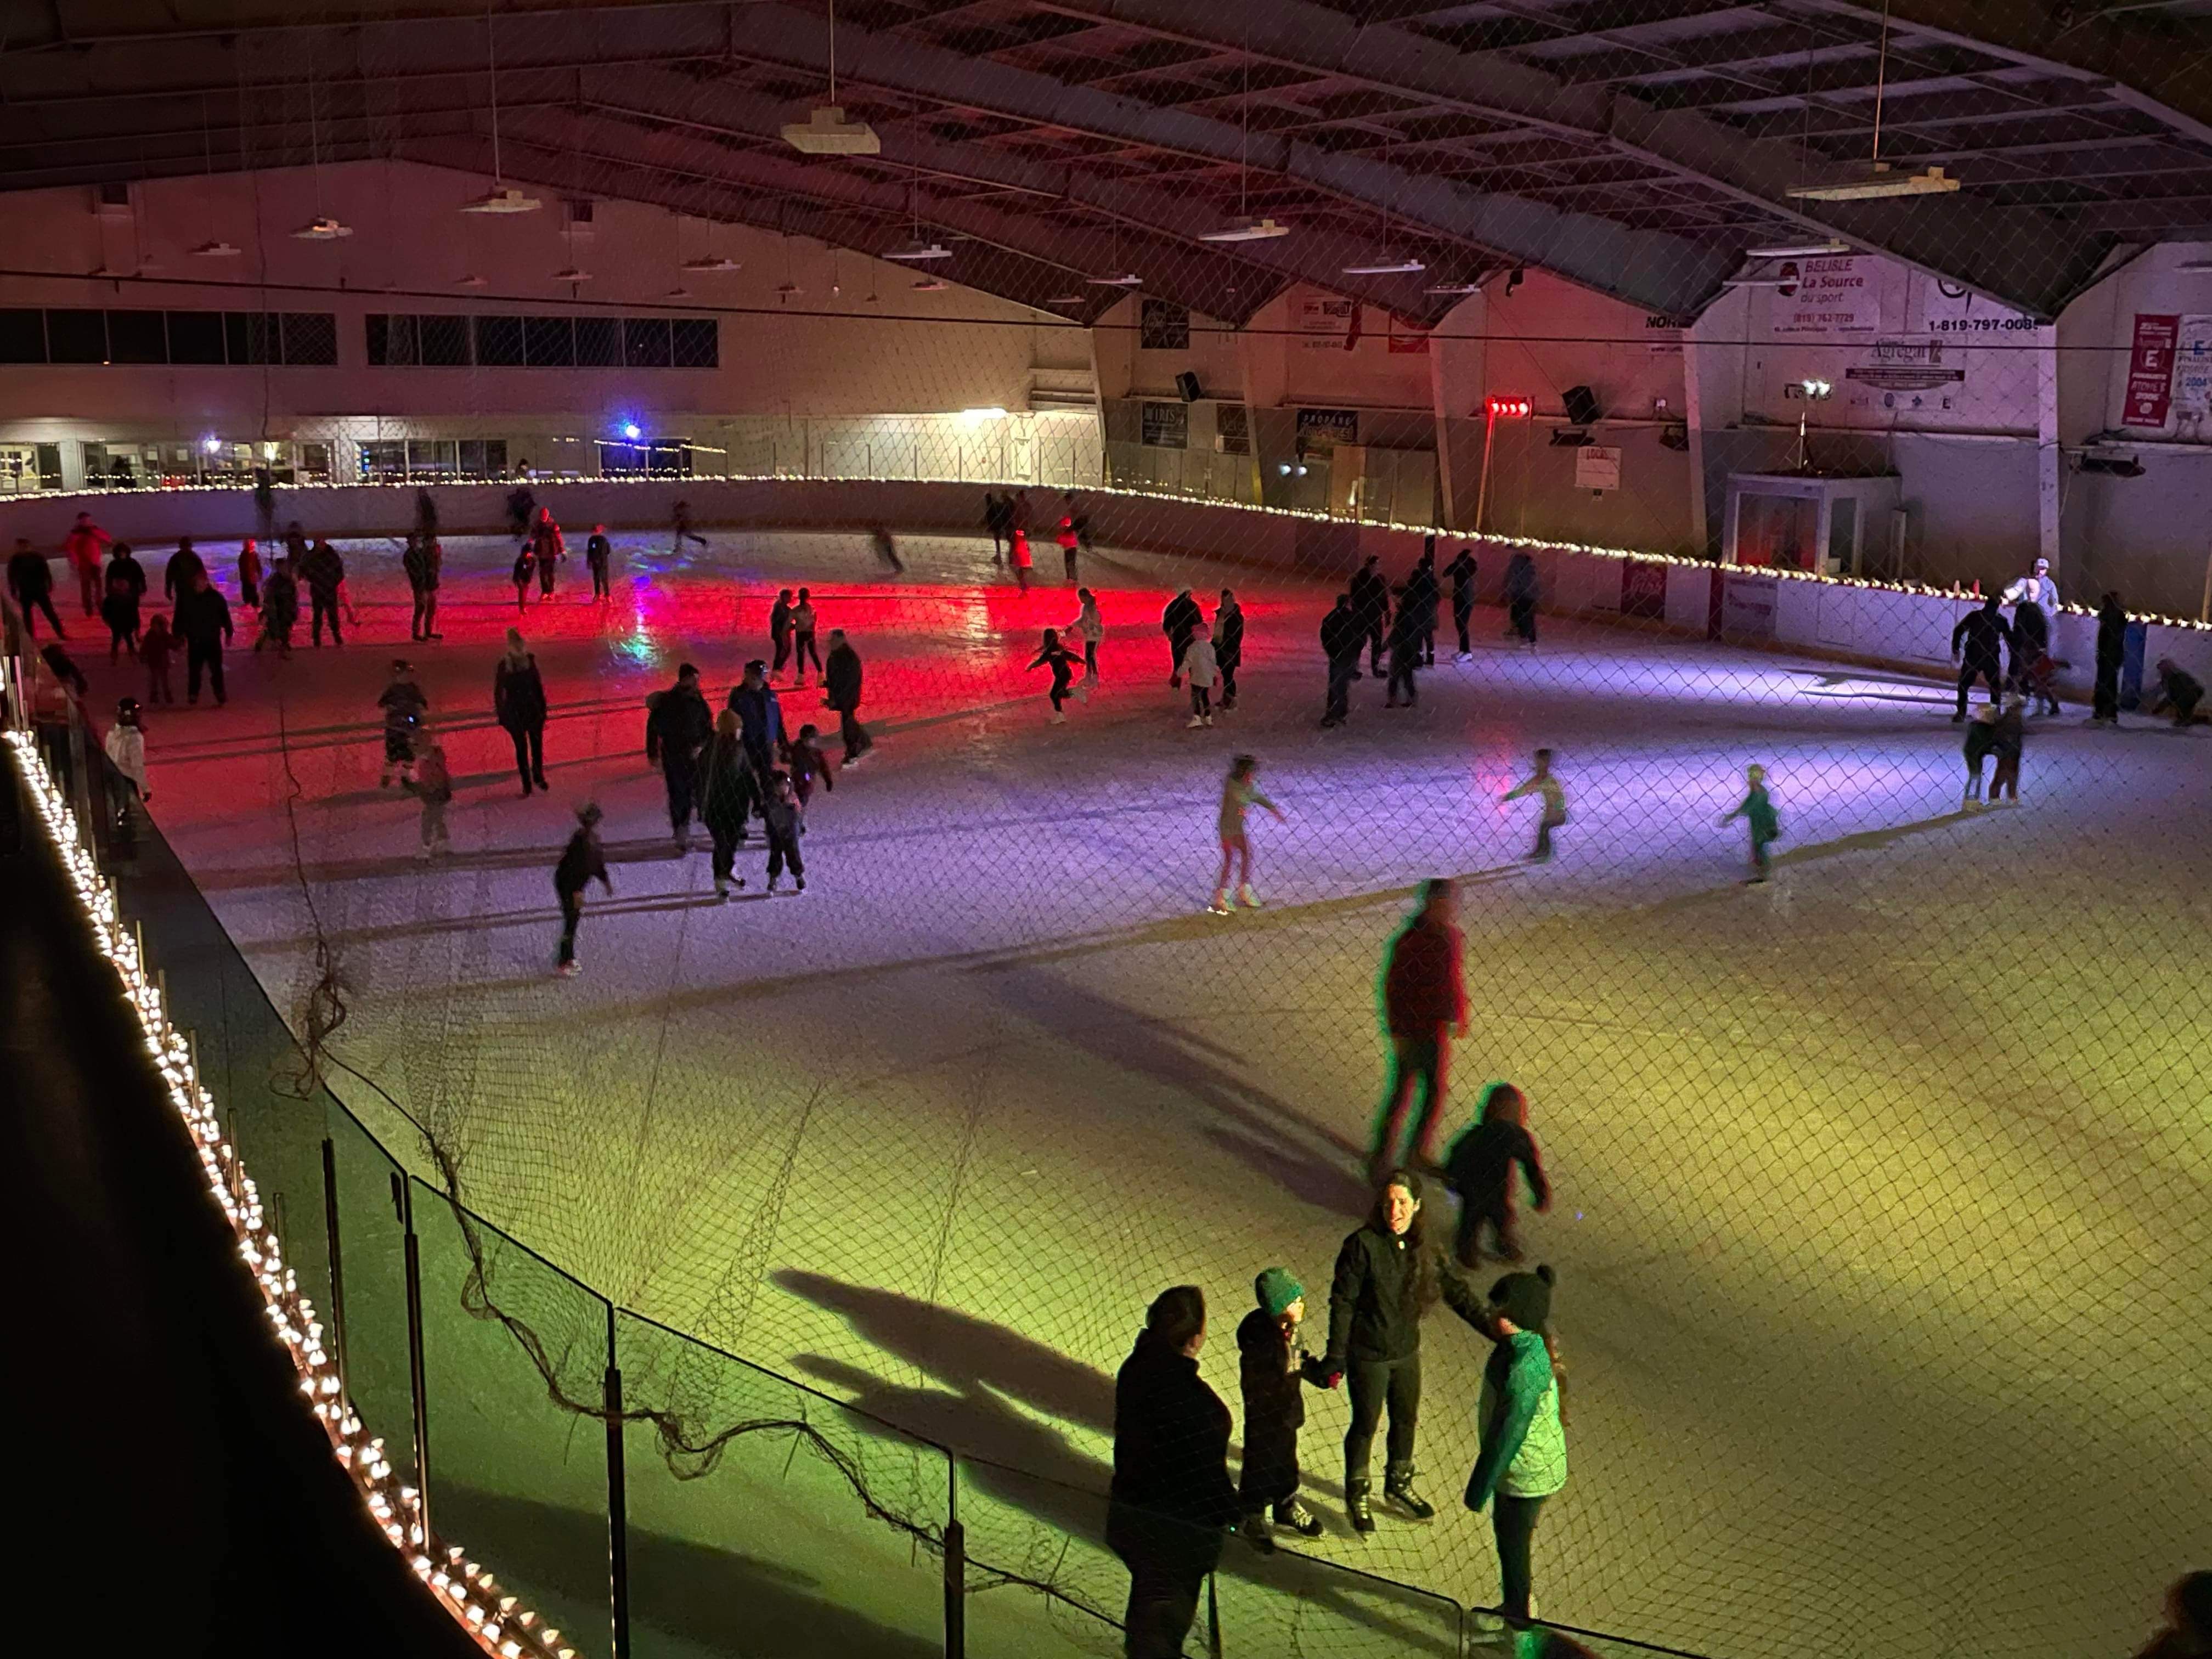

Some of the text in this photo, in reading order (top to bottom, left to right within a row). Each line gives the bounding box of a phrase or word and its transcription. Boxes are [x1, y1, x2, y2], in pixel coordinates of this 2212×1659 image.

[1805, 259, 1853, 272] BELISLE
[1802, 276, 1864, 288] La Source
[1801, 292, 1844, 304] du sport
[1794, 313, 1854, 323] (819) 762-7729
